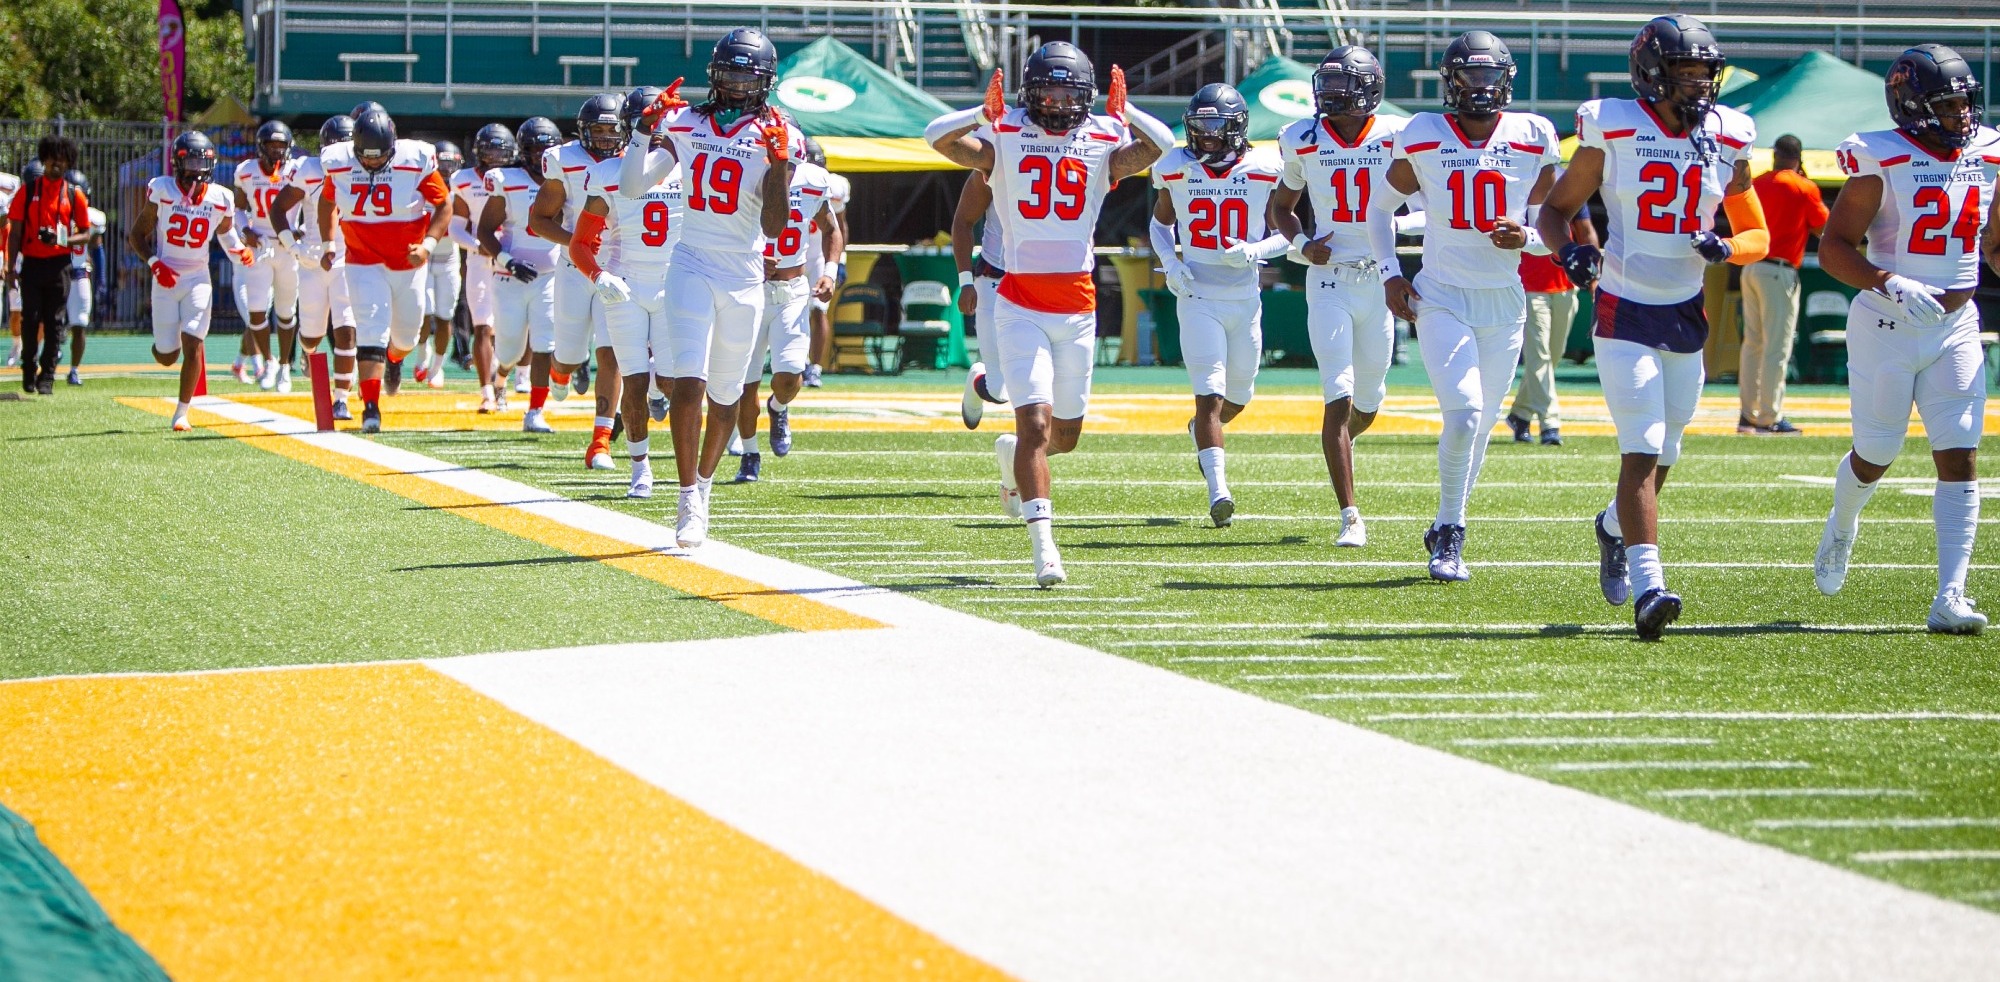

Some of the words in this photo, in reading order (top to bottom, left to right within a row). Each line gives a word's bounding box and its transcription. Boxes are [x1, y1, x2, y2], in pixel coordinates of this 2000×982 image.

[691, 141, 723, 153] VIRGINIA
[726, 148, 752, 159] STATE
[1020, 144, 1060, 153] VIRGINIA
[1063, 146, 1089, 157] STATE
[1319, 158, 1355, 166] VIRGINIA
[1358, 157, 1382, 165] STATE
[1441, 159, 1481, 168] VIRGINIA
[1484, 159, 1511, 168] STATE
[1635, 148, 1680, 159] VIRGINIA
[1684, 151, 1714, 162] STAE
[1836, 149, 1859, 175] 24
[688, 152, 744, 215] 19
[1018, 154, 1088, 221] 39
[1224, 188, 1248, 196] STATE
[1913, 173, 1953, 182] VIRGINIA
[1957, 173, 1982, 182] STATE
[350, 183, 392, 216] 79
[1330, 167, 1370, 223] 11
[1446, 169, 1506, 233] 10
[1637, 160, 1702, 235] 21
[167, 213, 209, 249] 29
[641, 201, 669, 247] 9
[1188, 197, 1249, 251] 20
[1908, 185, 1980, 255] 24
